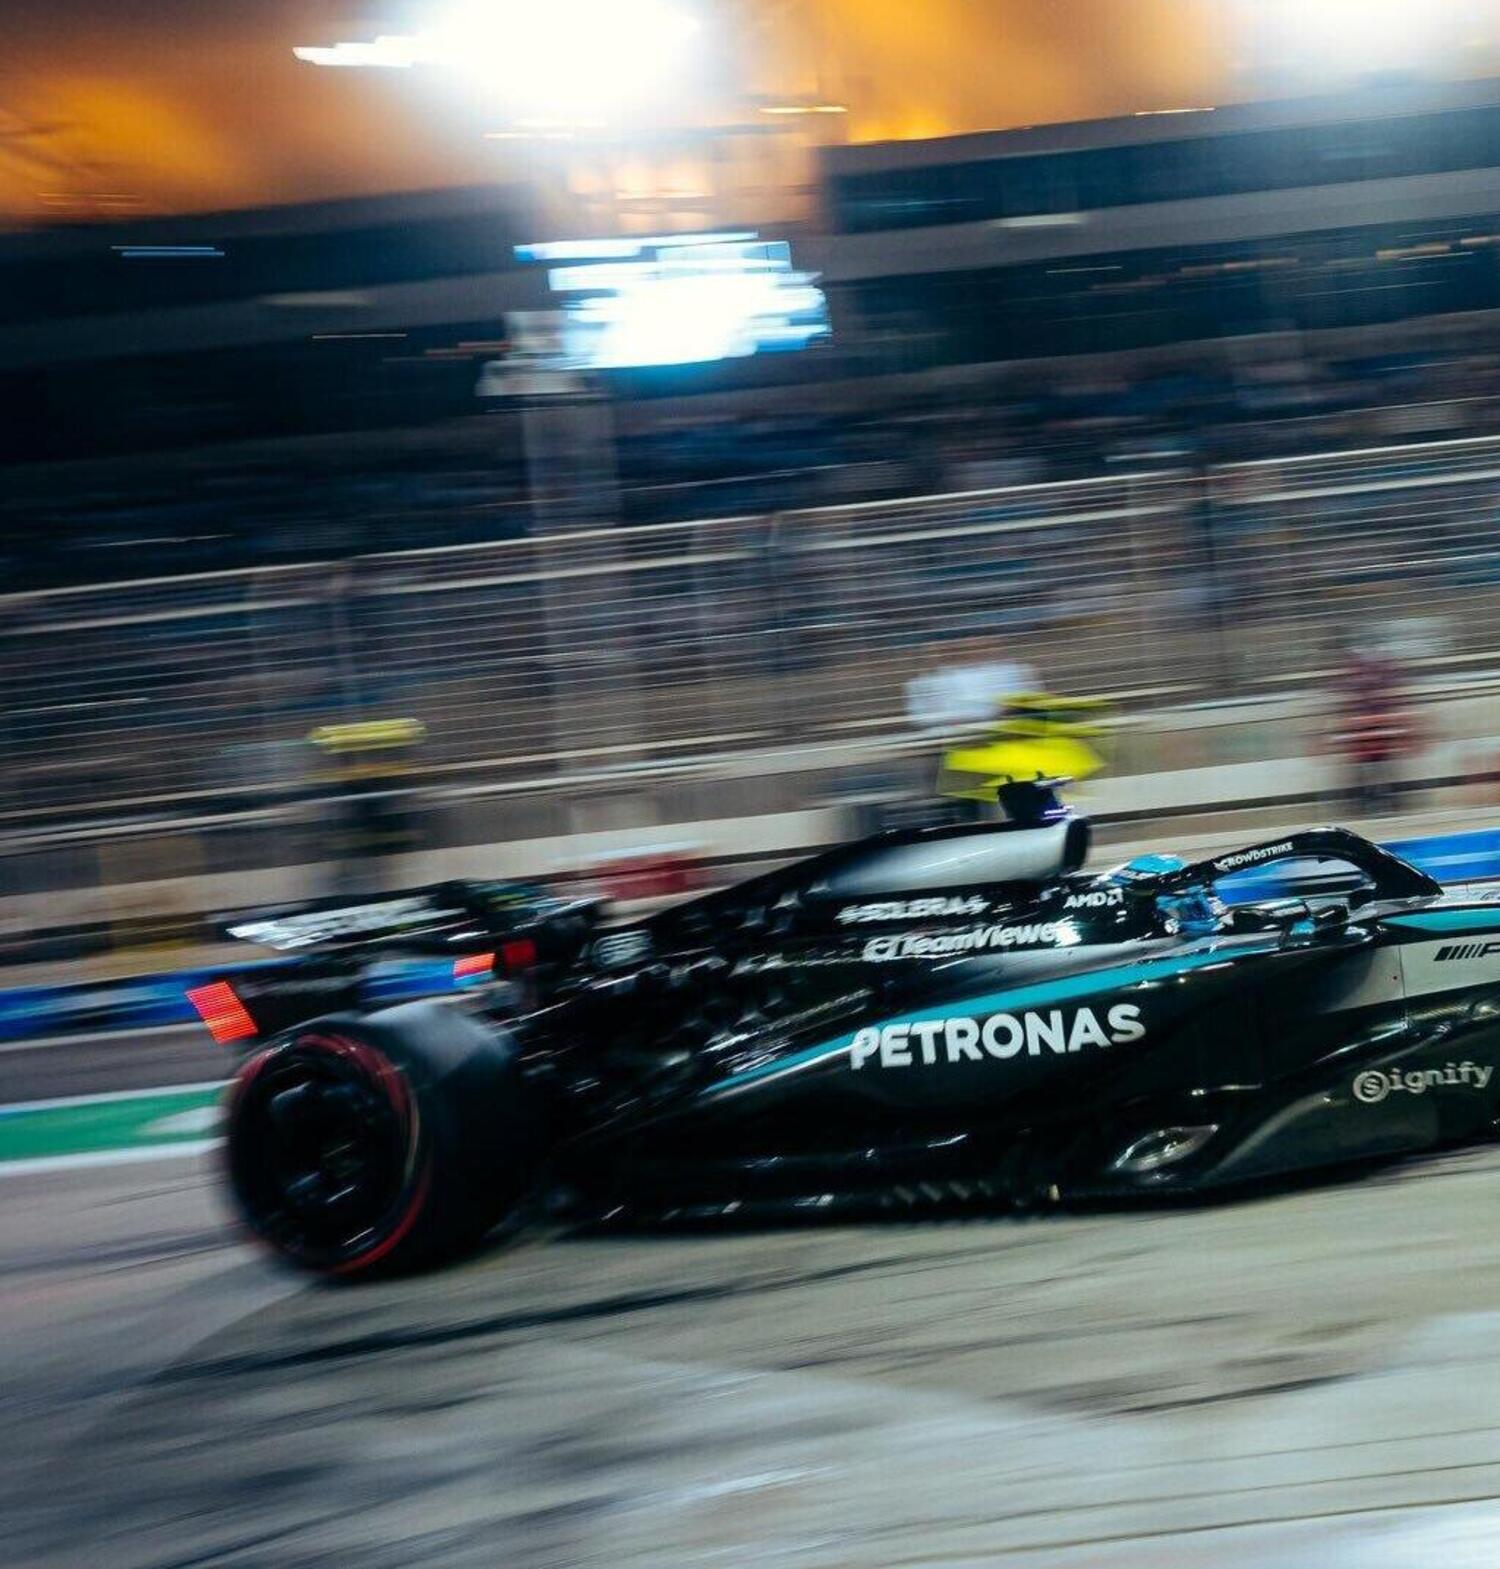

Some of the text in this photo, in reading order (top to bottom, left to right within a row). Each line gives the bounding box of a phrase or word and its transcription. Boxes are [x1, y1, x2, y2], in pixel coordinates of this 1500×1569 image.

[1063, 891, 1106, 909] AMD
[901, 917, 1081, 956] TeamViewe
[849, 1003, 1147, 1071] PETRONAS
